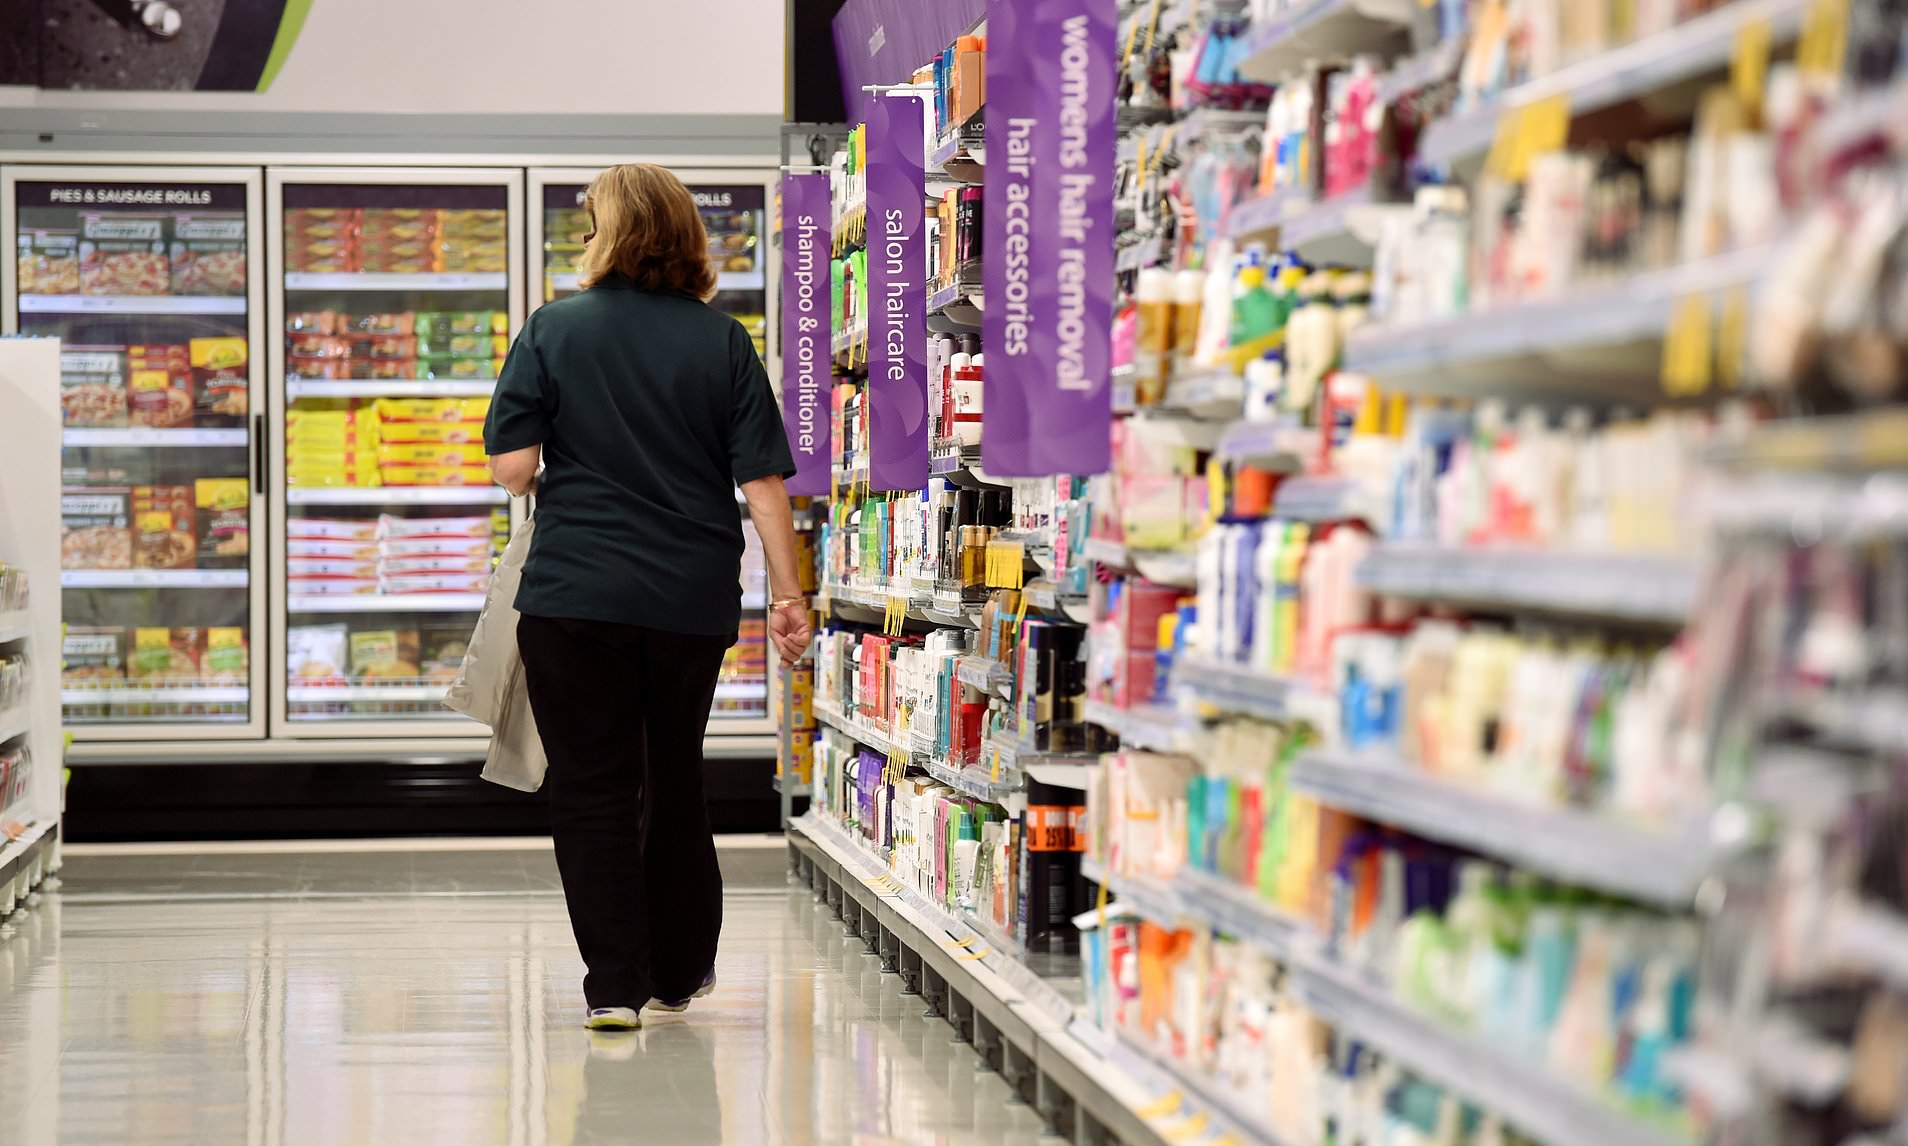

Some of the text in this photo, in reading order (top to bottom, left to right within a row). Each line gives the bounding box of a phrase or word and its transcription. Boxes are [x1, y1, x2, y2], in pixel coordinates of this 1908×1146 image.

[50, 189, 212, 204] PIES & SAUSAGE ROLLS
[885, 209, 910, 380] salon haircare
[1005, 118, 1038, 356] hair accessories
[1056, 15, 1096, 391] womens hair removal
[794, 215, 818, 455] shampoo & conditioner
